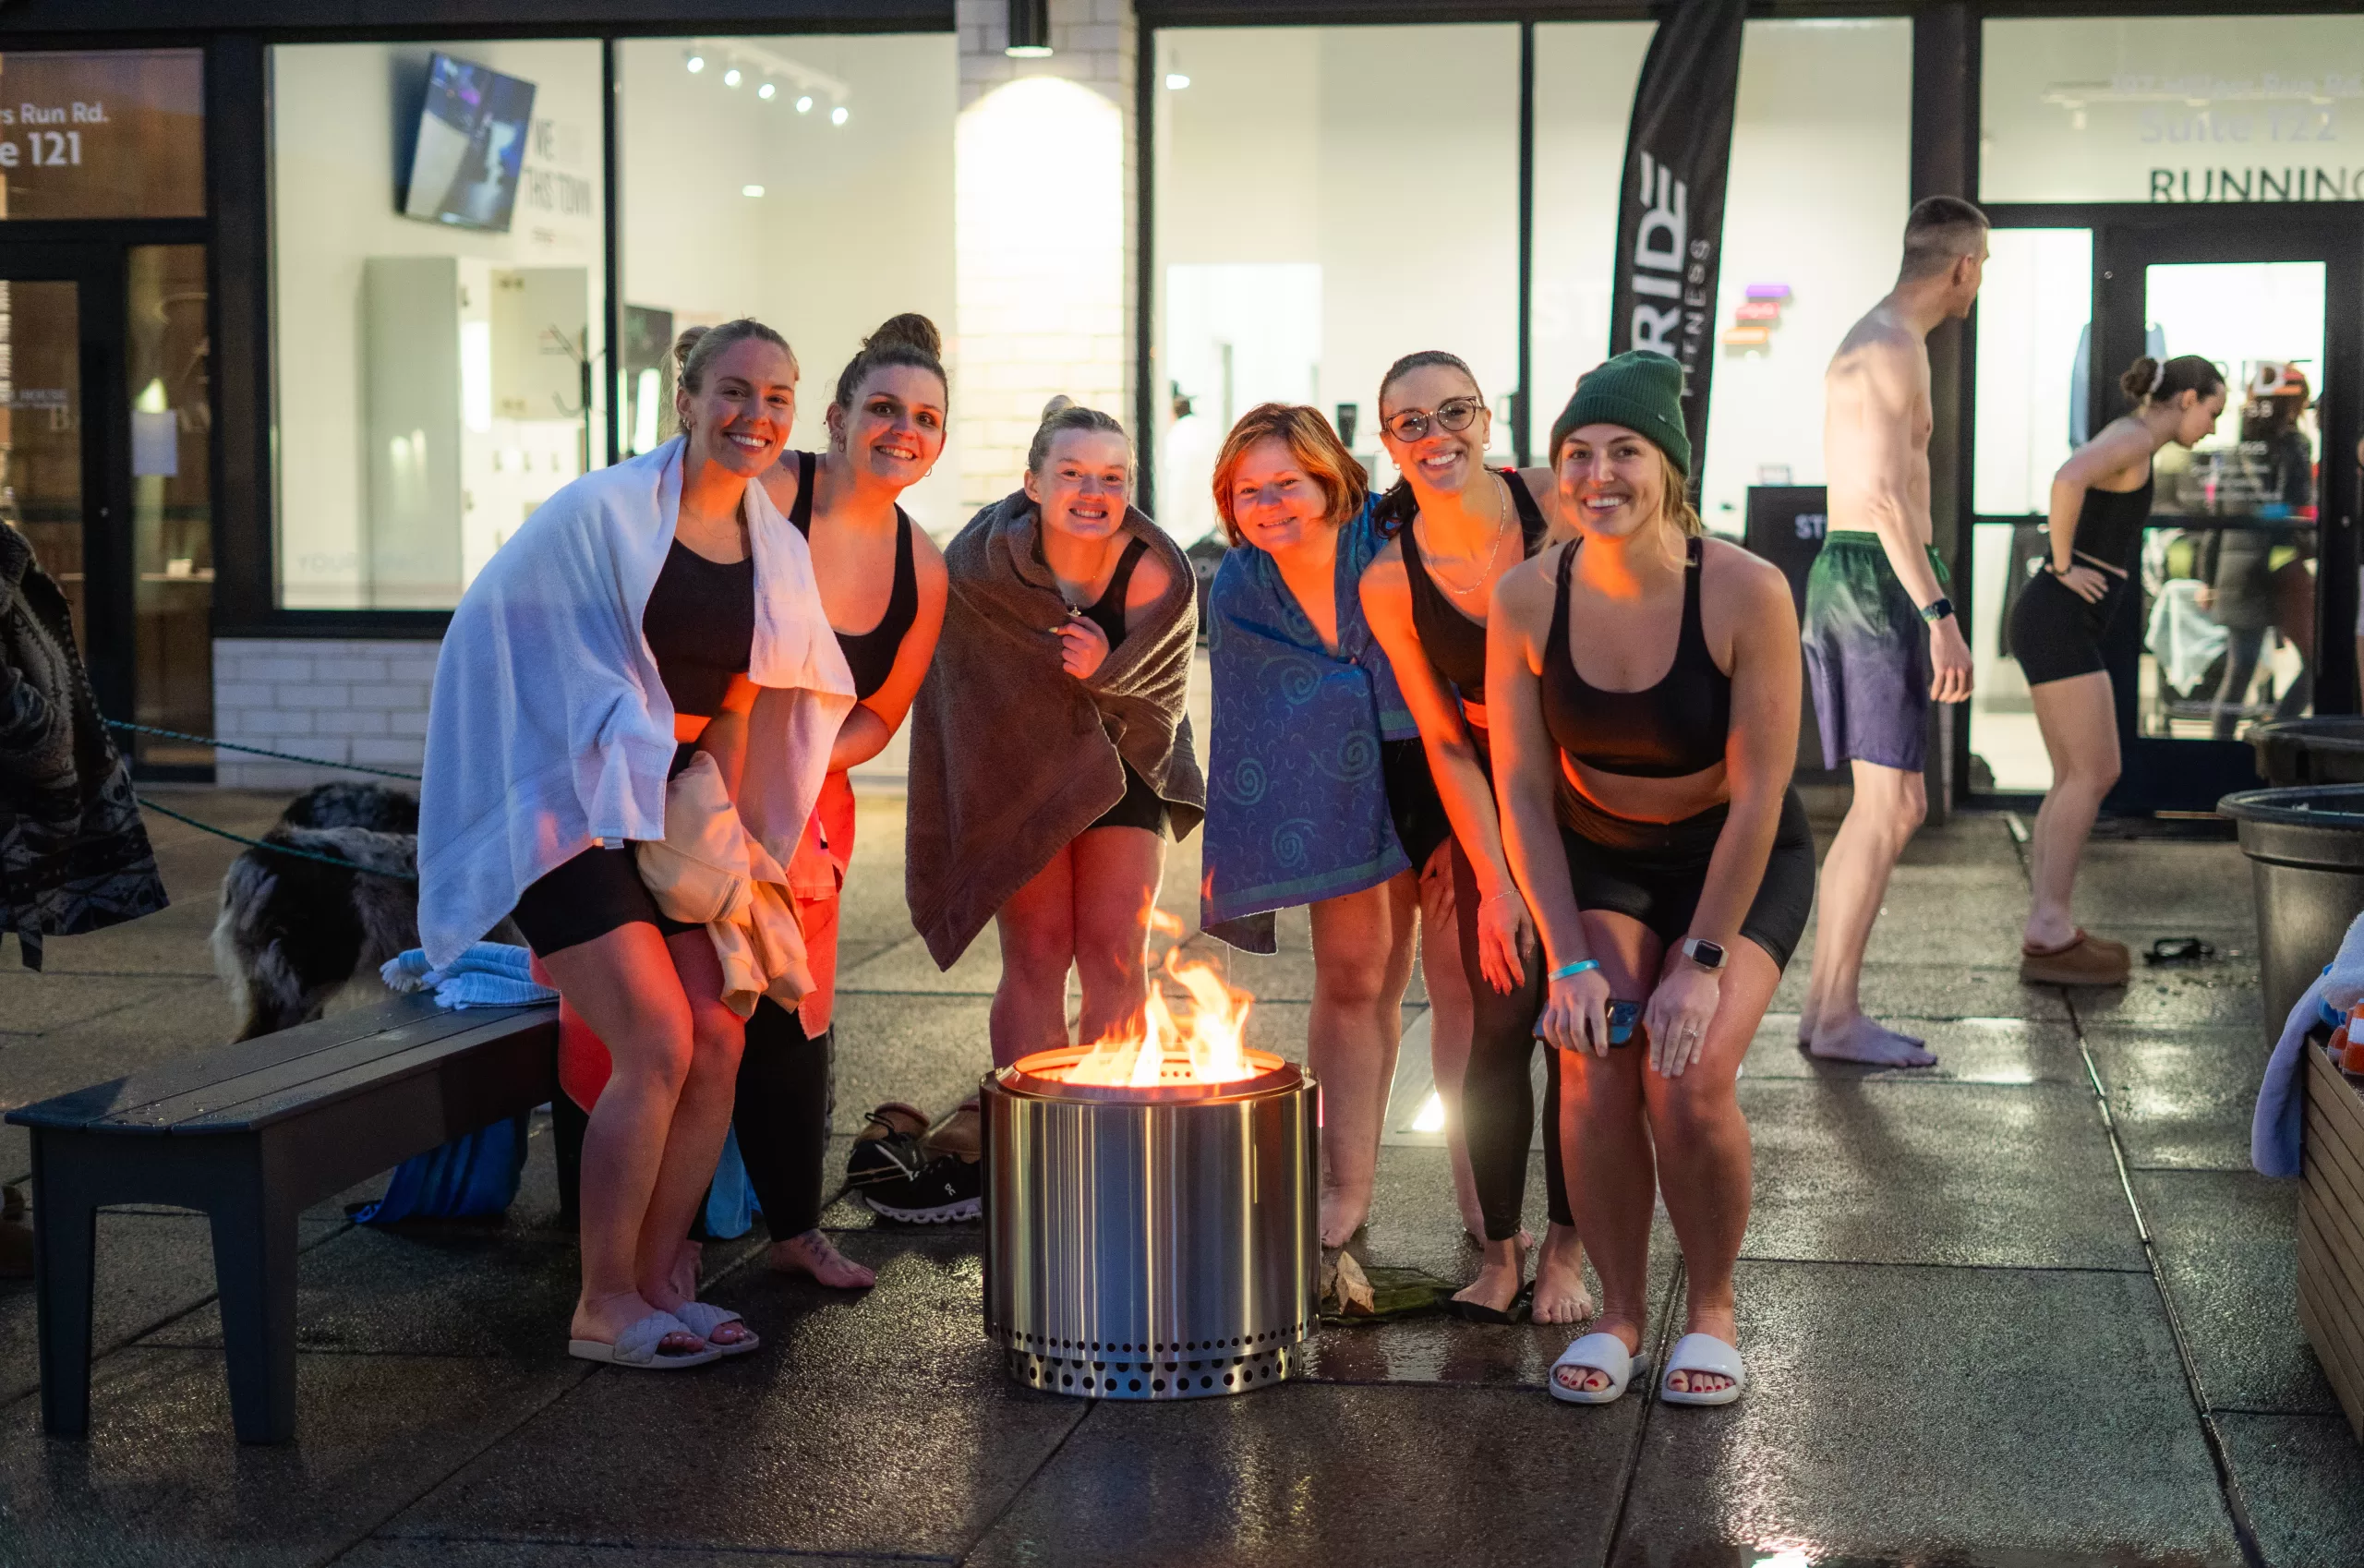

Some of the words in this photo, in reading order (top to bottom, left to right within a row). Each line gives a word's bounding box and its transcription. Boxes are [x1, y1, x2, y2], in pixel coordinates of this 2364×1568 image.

[20, 102, 66, 124] Run
[72, 100, 110, 123] Rd.
[2140, 108, 2253, 144] Suite
[2267, 106, 2337, 142] 122
[27, 130, 82, 166] 121
